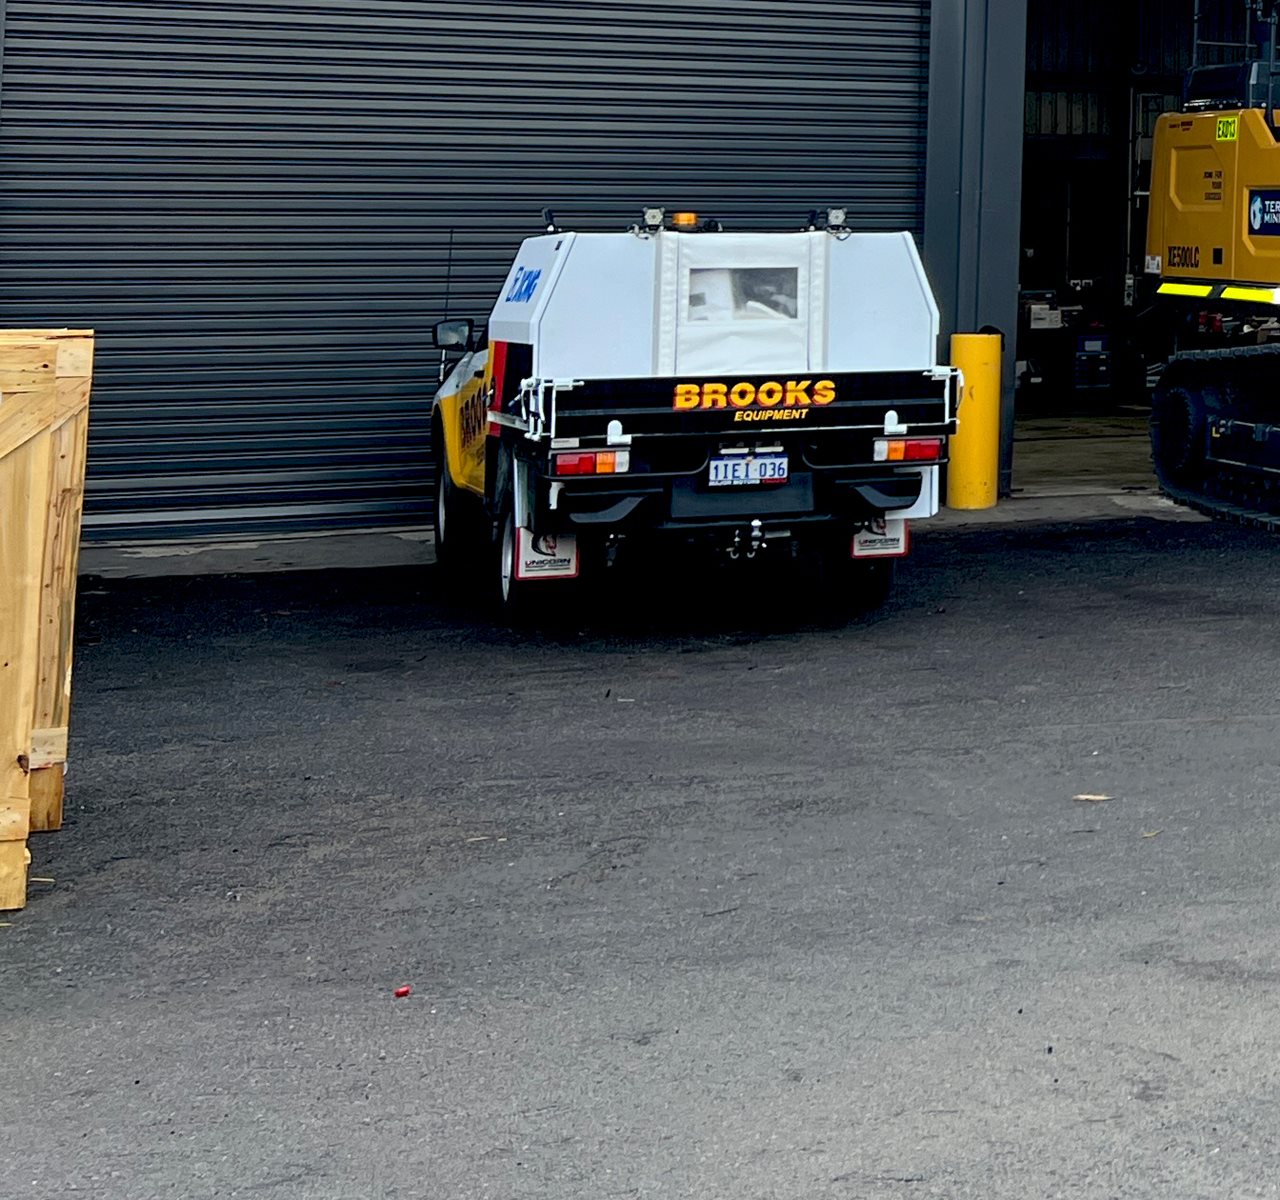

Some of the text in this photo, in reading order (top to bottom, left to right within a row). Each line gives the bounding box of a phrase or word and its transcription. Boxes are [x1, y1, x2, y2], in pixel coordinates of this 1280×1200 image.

[673, 380, 836, 411] BROOKS
[734, 409, 809, 422] EQUIPMENT
[759, 461, 785, 478] 036
